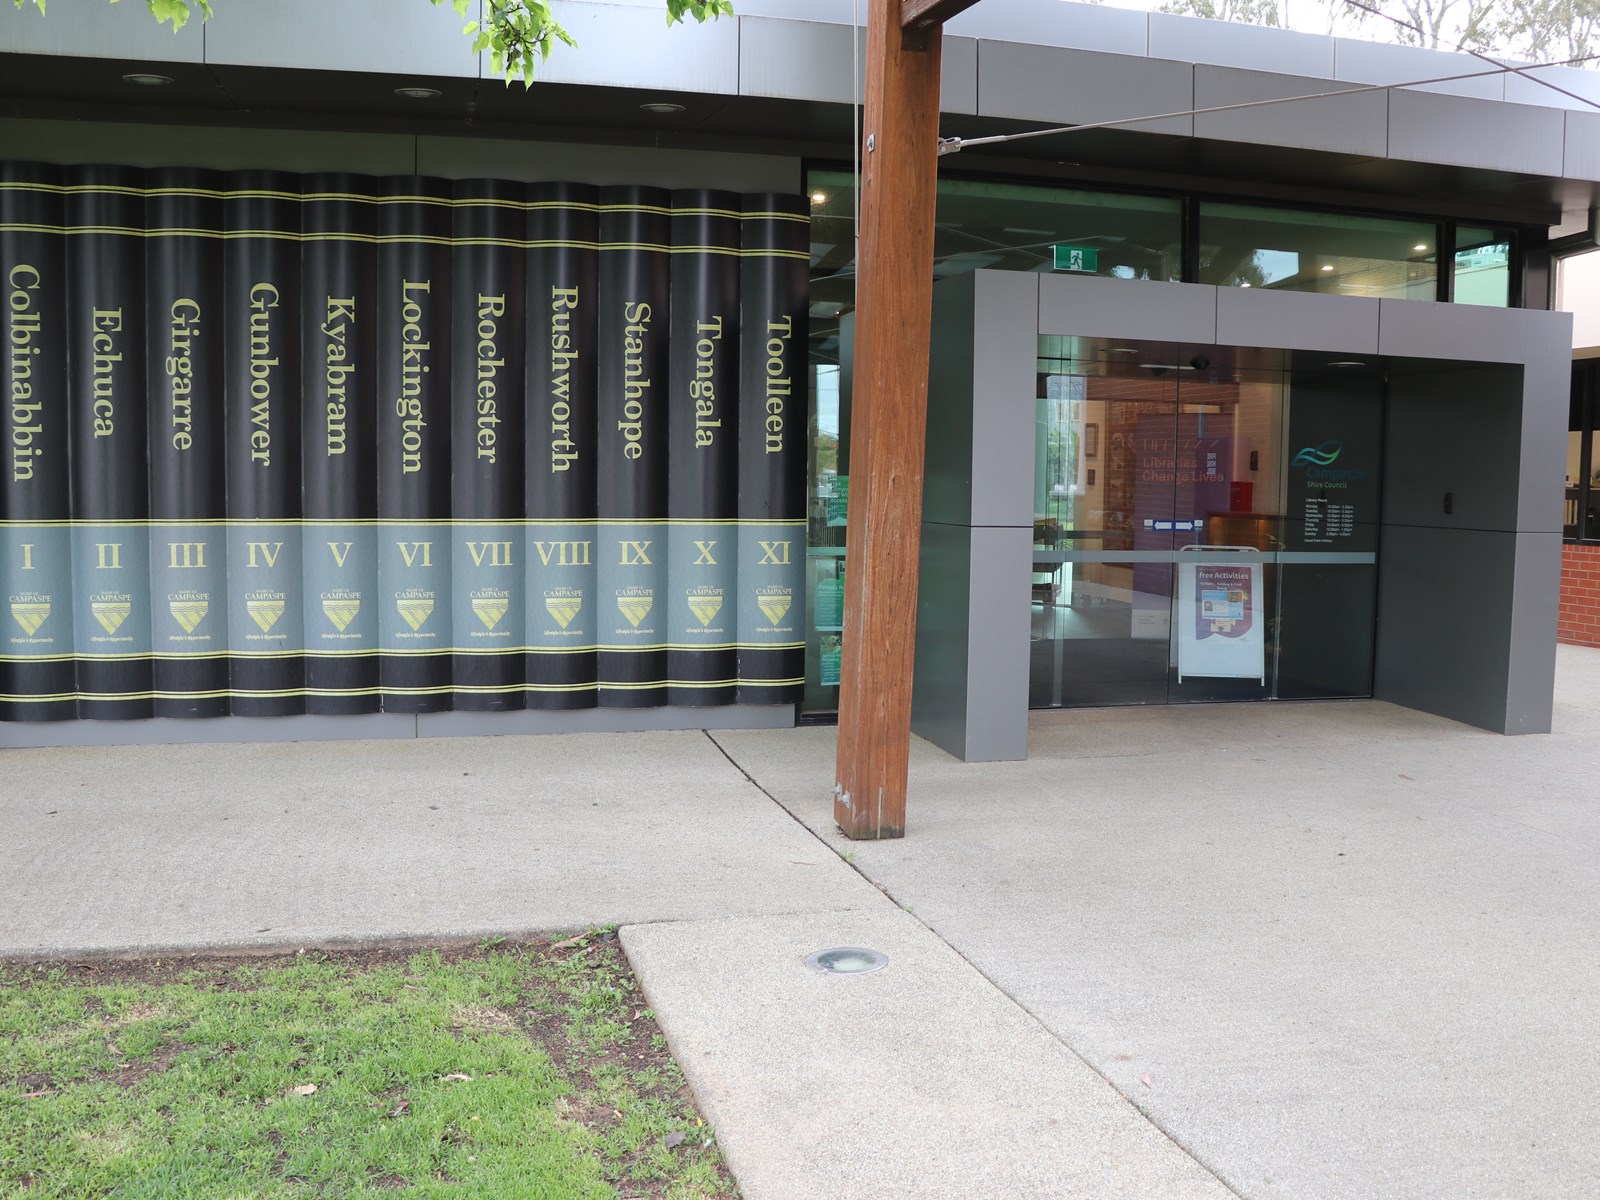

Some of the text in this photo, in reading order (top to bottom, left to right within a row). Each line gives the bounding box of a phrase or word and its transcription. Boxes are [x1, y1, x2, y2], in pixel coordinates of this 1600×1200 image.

[9, 264, 43, 481] Colbinabbin
[93, 307, 122, 438] Echuca
[166, 298, 200, 450] Girgarre
[250, 282, 279, 466] Gunbower
[320, 296, 355, 456] Kyabram
[396, 279, 430, 474] Lockington
[478, 293, 505, 464] Rochester
[551, 285, 578, 473] Rushworth
[618, 302, 652, 460] Stanhope
[689, 315, 722, 449] Tongala
[766, 315, 792, 454] Toolleen
[1143, 471, 1224, 485] Change Lives
[20, 544, 35, 569] I
[95, 543, 122, 569] II
[168, 543, 207, 568] III
[246, 542, 283, 568] IV
[327, 542, 353, 567] V
[396, 542, 433, 567] VI
[466, 542, 513, 566] VII
[533, 541, 591, 566] VIII
[618, 541, 652, 565] IX
[693, 541, 717, 565] X
[758, 541, 791, 565] XI
